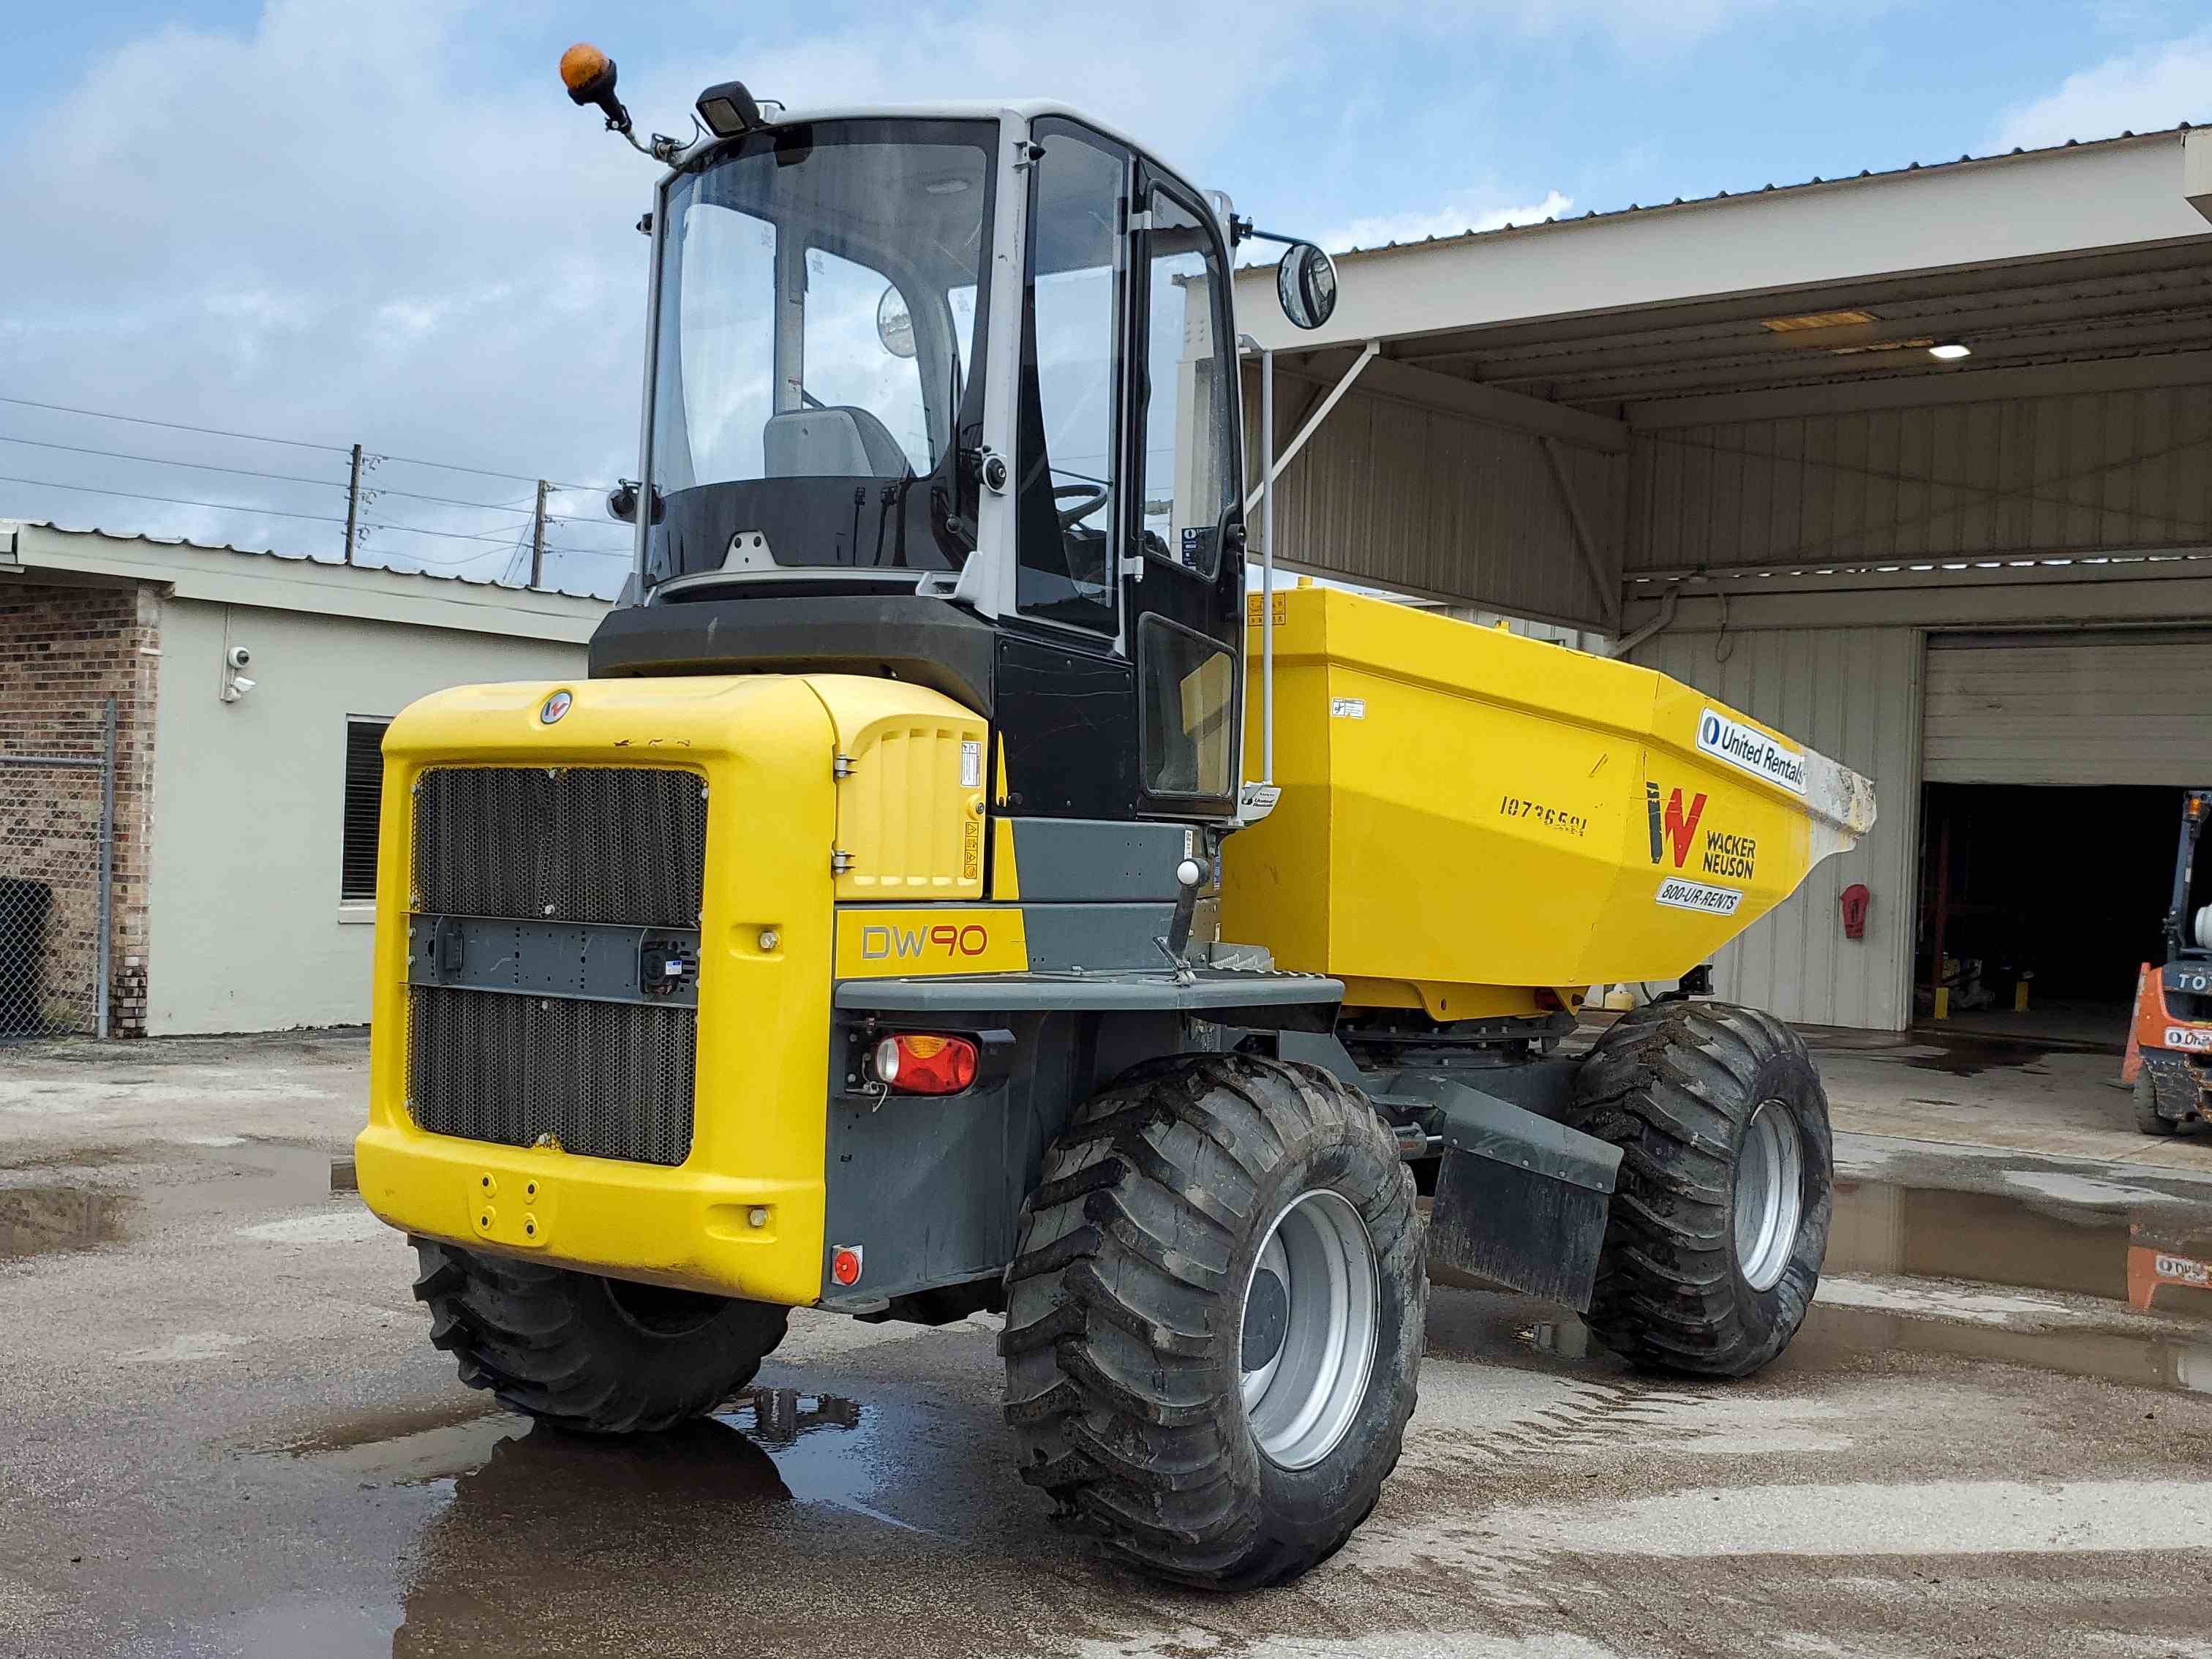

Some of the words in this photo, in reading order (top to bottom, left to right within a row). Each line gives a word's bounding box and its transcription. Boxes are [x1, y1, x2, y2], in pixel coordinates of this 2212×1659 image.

[1721, 726, 1764, 765] United
[1763, 746, 1804, 786] Rentals
[1707, 830, 1756, 859] WACKER
[1702, 851, 1755, 880] NEUSON
[1661, 884, 1737, 910] 800-UR-RENTS
[862, 925, 988, 960] DW90
[2178, 974, 2212, 990] TO
